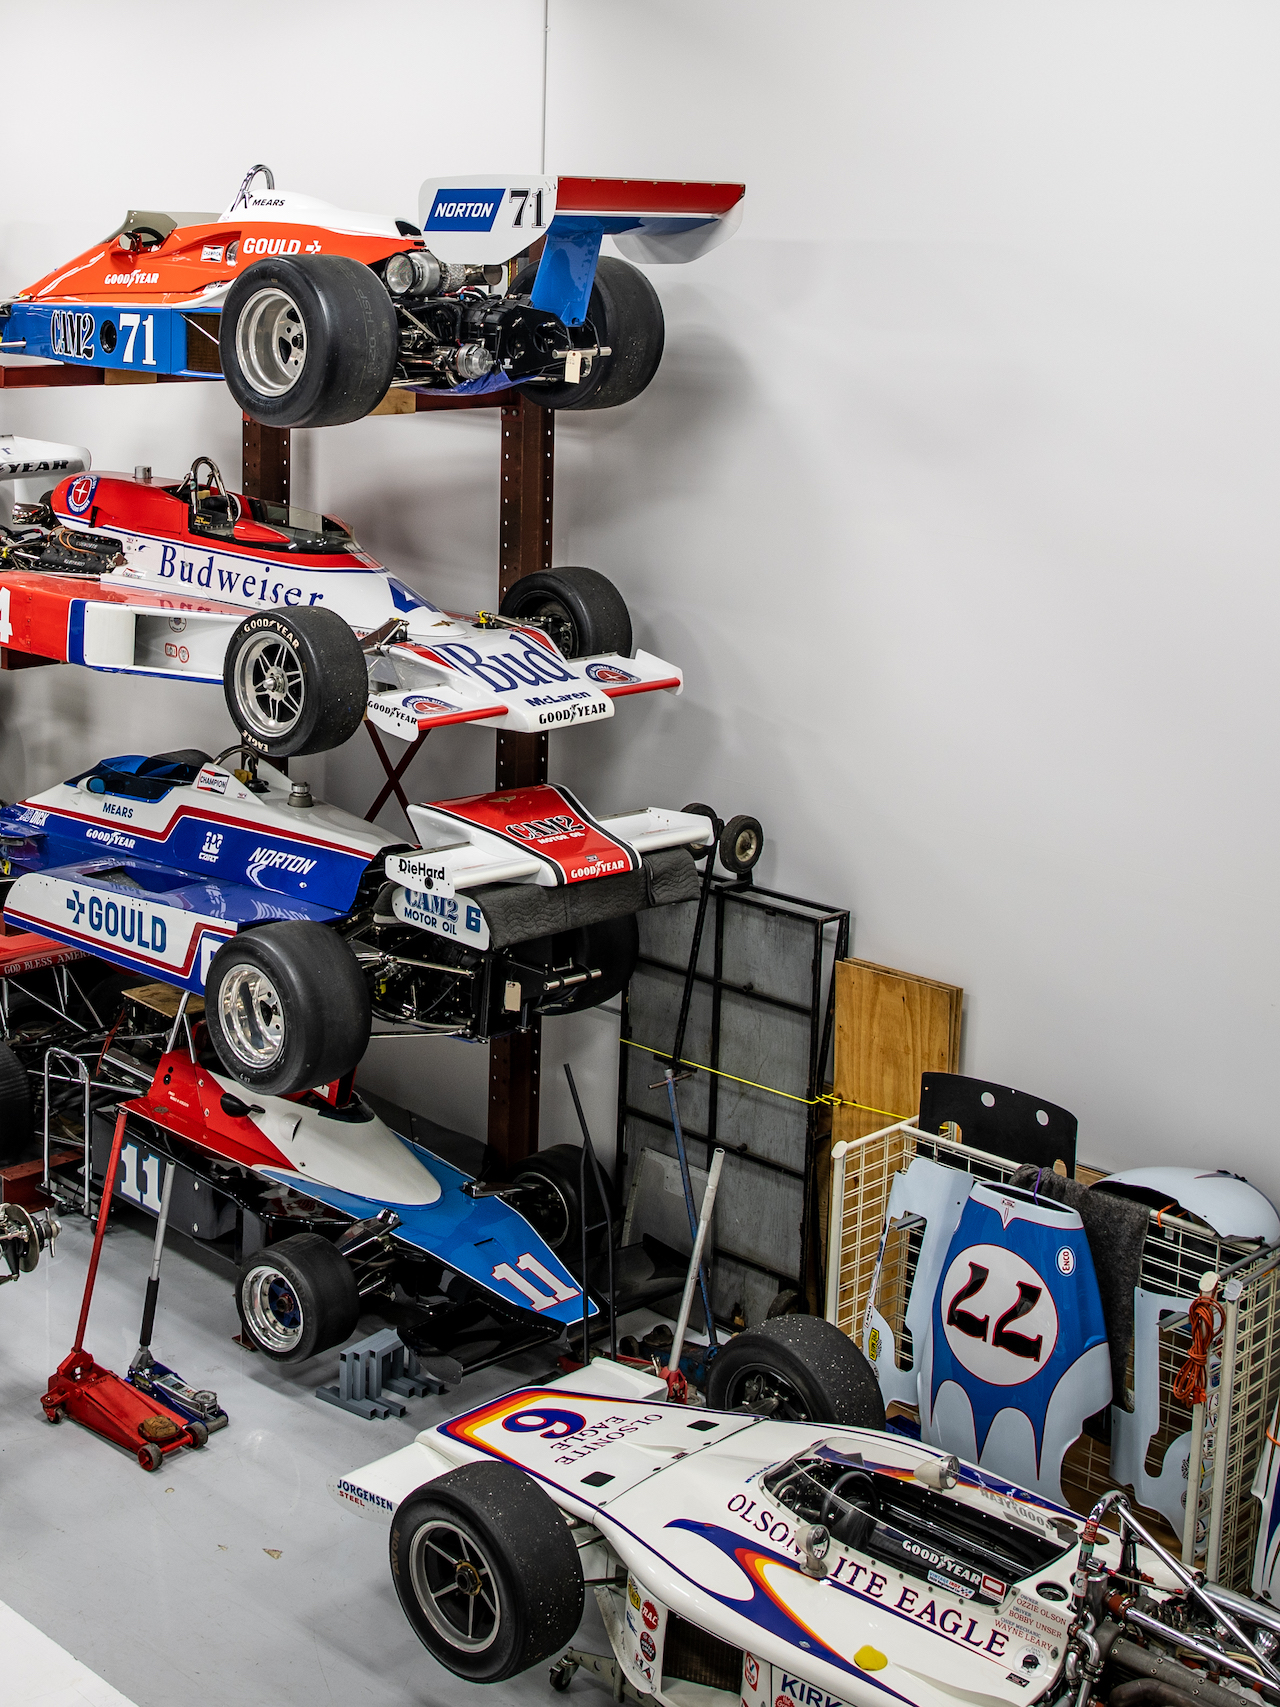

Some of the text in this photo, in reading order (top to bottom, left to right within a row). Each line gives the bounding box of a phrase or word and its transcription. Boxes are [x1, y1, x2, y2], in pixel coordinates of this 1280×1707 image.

[252, 198, 286, 207] MEARS
[433, 201, 495, 219] NORTON
[507, 187, 547, 229] 71
[242, 237, 301, 255] GOULD
[50, 309, 96, 361] CAM2
[118, 312, 157, 366] 71
[157, 543, 324, 608] Budweiser
[433, 633, 581, 693] Bud
[524, 691, 592, 707] McLaren
[241, 729, 269, 752] EAGLE
[200, 774, 228, 789] CHAMPION
[102, 802, 134, 819] MEARS
[505, 814, 586, 841] CAM2
[536, 830, 586, 845] MOTOR OIL
[248, 846, 318, 875] NORTON
[398, 857, 446, 882] DieHard
[404, 888, 459, 923] CAM2
[465, 905, 482, 934] 6
[86, 895, 168, 954] GOULD
[403, 907, 458, 936] MOTOR OIL
[4, 950, 93, 975] GOD BLESS AMERI
[120, 1141, 162, 1215] 11
[1061, 1250, 1070, 1272] ENCO
[491, 1252, 582, 1313] 11
[501, 1408, 588, 1440] 6
[549, 1414, 629, 1452] EAGLE
[553, 1412, 663, 1467] OLSONITE
[336, 1479, 394, 1512] JORGENSEN
[339, 1490, 366, 1508] STEEL
[391, 1528, 401, 1576] AVON
[928, 1570, 962, 1590] VINTAGE INDY
[1012, 1605, 1033, 1618] DRIVER
[1016, 1597, 1068, 1626] OZZIE OLSON
[1020, 1593, 1040, 1606] OWNER
[894, 1592, 1013, 1658] EAGLE
[994, 1618, 1054, 1652] WAYNE LEARY
[1000, 1616, 1042, 1639] CHIEF MECHANIC
[1008, 1609, 1063, 1639] BOBBY UNSER
[781, 1672, 844, 1707] KIRK
